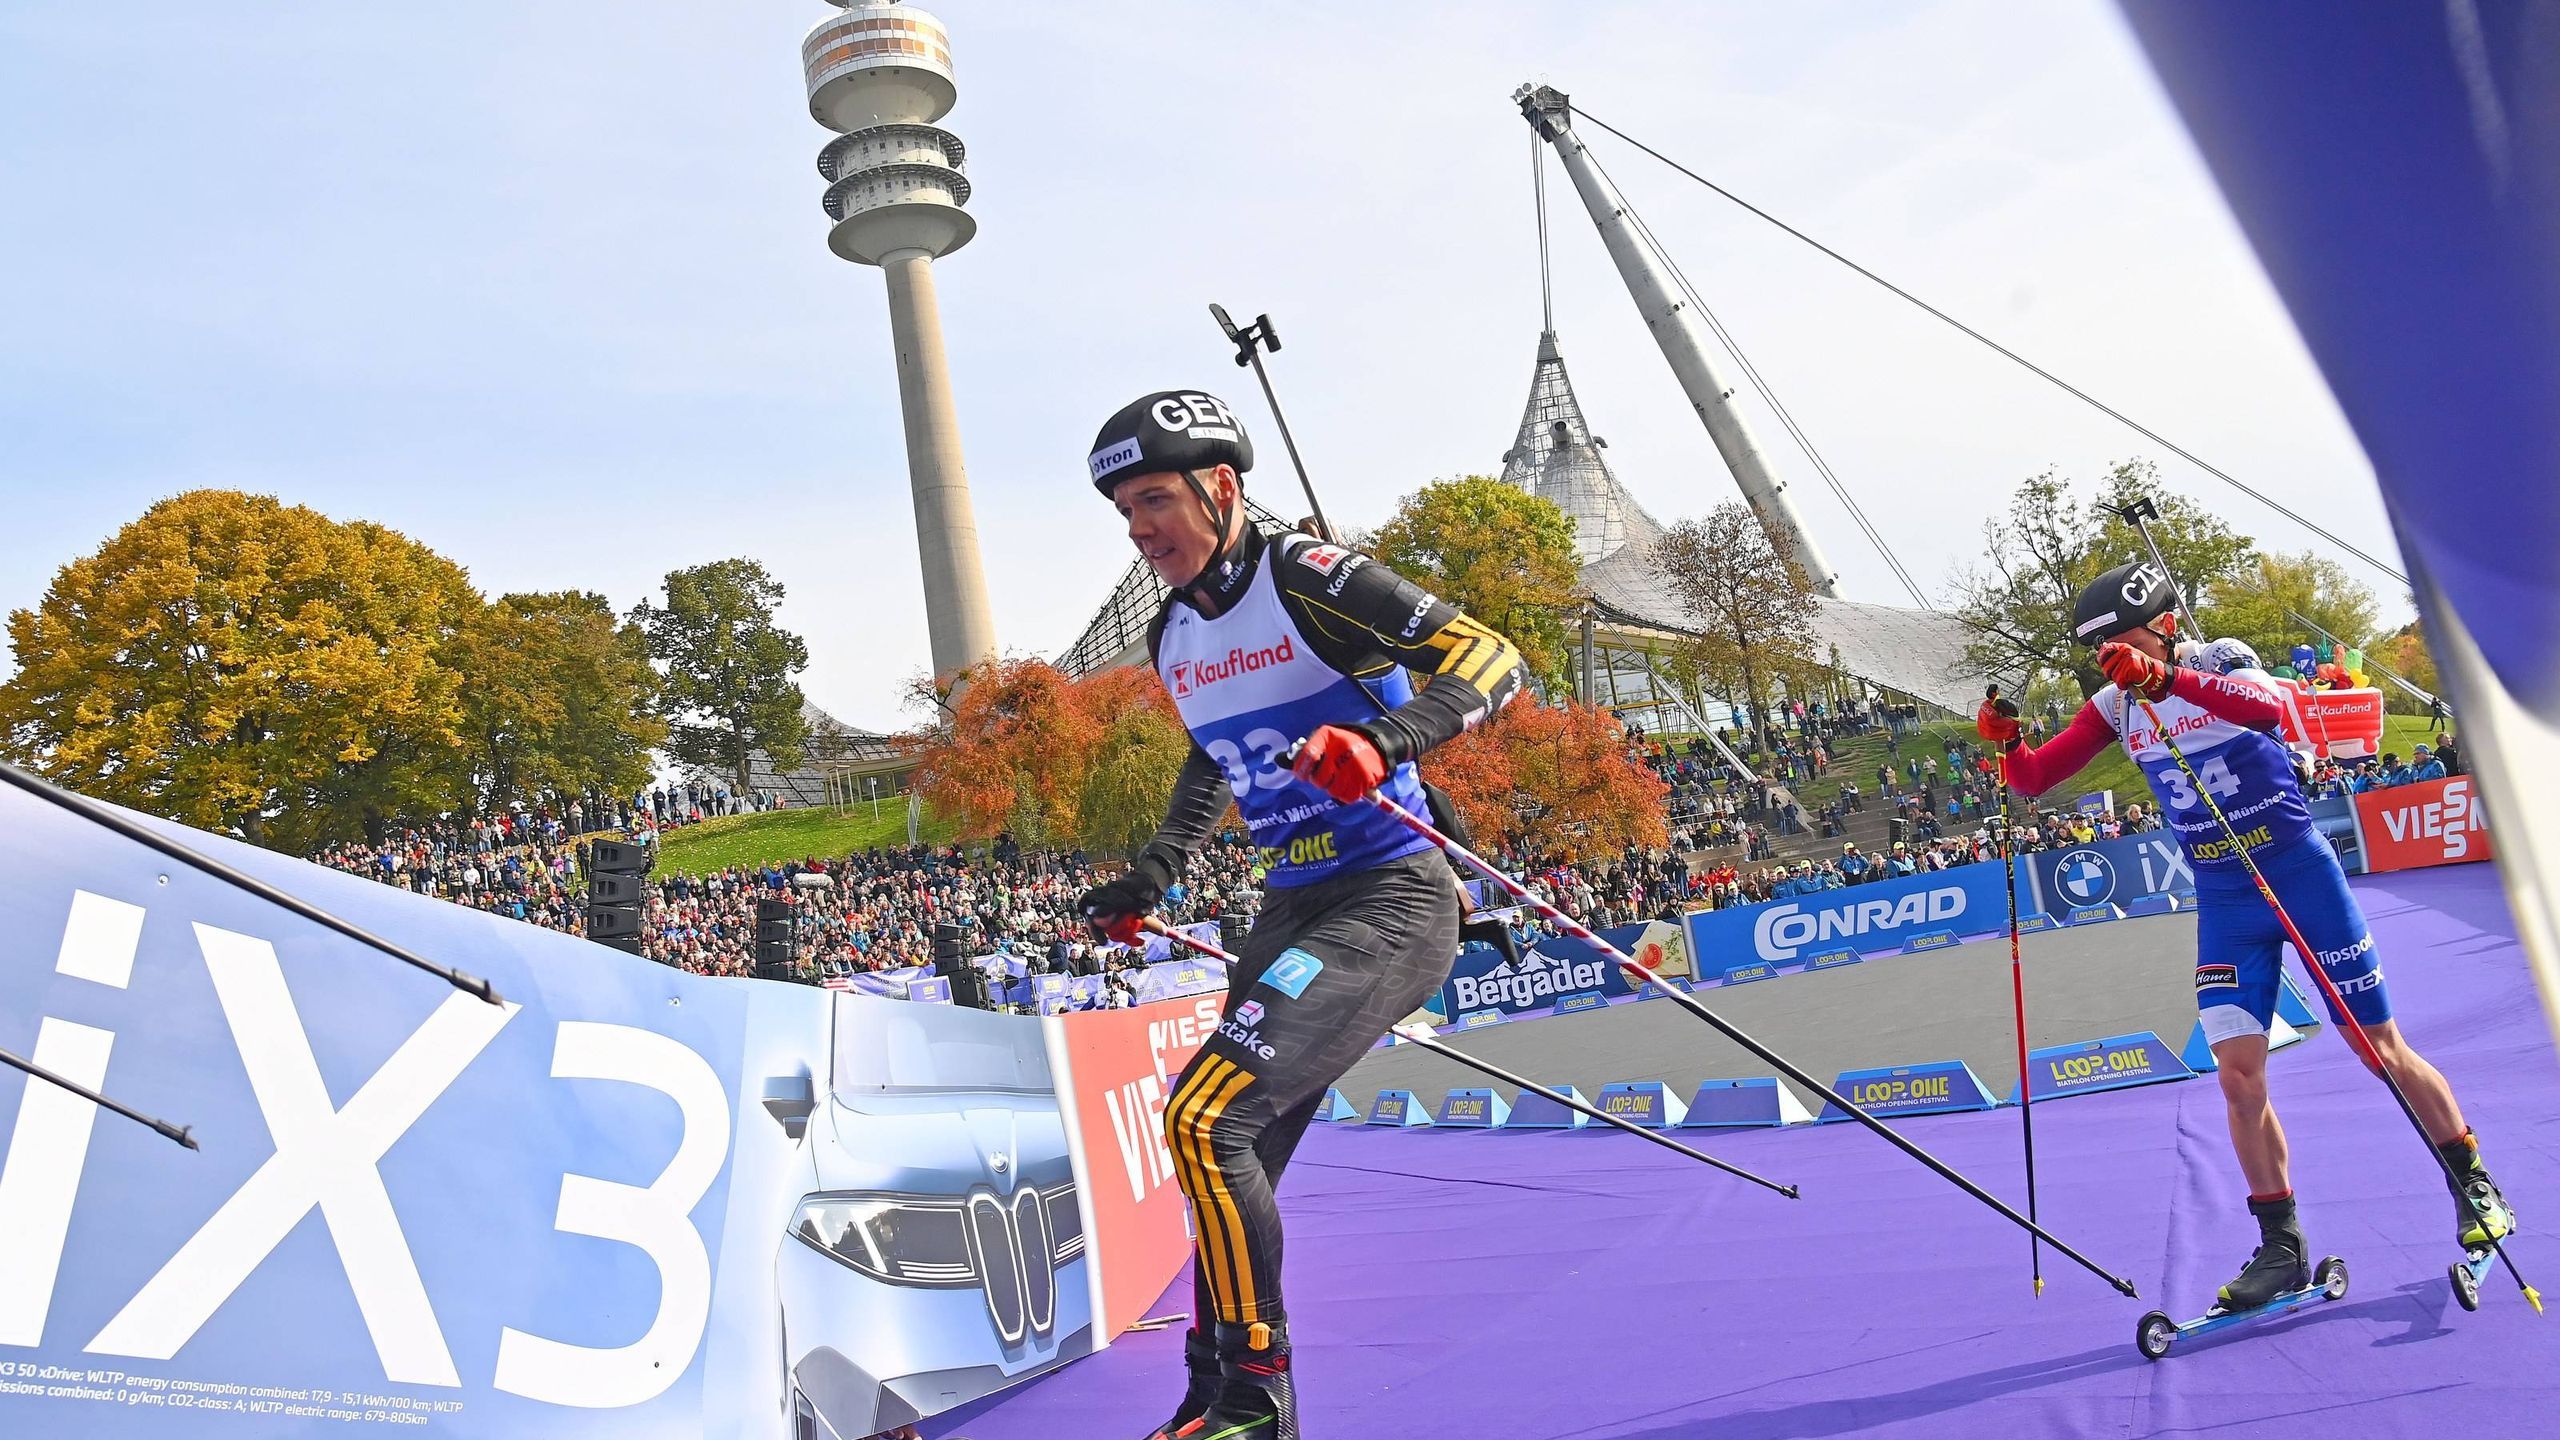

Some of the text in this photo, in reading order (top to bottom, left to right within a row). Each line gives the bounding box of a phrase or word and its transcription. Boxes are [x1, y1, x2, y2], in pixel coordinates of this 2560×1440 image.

[1152, 395, 1244, 437] GER
[1091, 446, 1134, 473] otron
[1194, 635, 1295, 688] Kaufland
[2320, 702, 2372, 716] Kaufland
[1205, 728, 1297, 798] 33
[2158, 755, 2242, 810] 34
[2227, 790, 2287, 822] München
[1289, 831, 1339, 865] ONE
[2061, 853, 2104, 873] BMW
[1754, 886, 1967, 961] CONRAD
[2317, 933, 2374, 967] Tipsport
[1453, 959, 1605, 1010] Bergader
[2197, 972, 2232, 985] Hamé
[2050, 1048, 2150, 1080] LOOP ONE
[2056, 1067, 2153, 1087] BIATHLON OPENING FESTIVAL
[1605, 1095, 1653, 1113] LOOP ONE
[1853, 1076, 1949, 1104] LOOP ONE
[1887, 1098, 1919, 1107] OPENING
[1919, 1096, 1950, 1104] FESTIVAL
[1377, 1100, 1392, 1113] LOOP
[1448, 1100, 1484, 1115] LOOP ONE
[0, 888, 733, 1409] iX3
[18, 1363, 37, 1377] 50
[38, 1366, 84, 1382] xDrive:
[87, 1370, 125, 1384] WLTP
[126, 1377, 169, 1391] energy
[171, 1379, 248, 1396] consumption
[250, 1386, 309, 1401] combined:
[311, 1390, 332, 1404] 17,9
[342, 1392, 361, 1405] 15,1
[362, 1394, 410, 1409] kWh/100
[412, 1398, 432, 1412] km;
[434, 1400, 463, 1413] WLTP
[47, 1383, 114, 1401] combined:
[117, 1389, 126, 1402] 0
[128, 1391, 165, 1407] g/km;
[168, 1394, 232, 1410] CO2-class:
[233, 1399, 248, 1413] A;
[250, 1400, 283, 1414] WLTP
[285, 1405, 325, 1417] electric
[327, 1409, 362, 1421] range:
[364, 1410, 428, 1425] 679-805km
